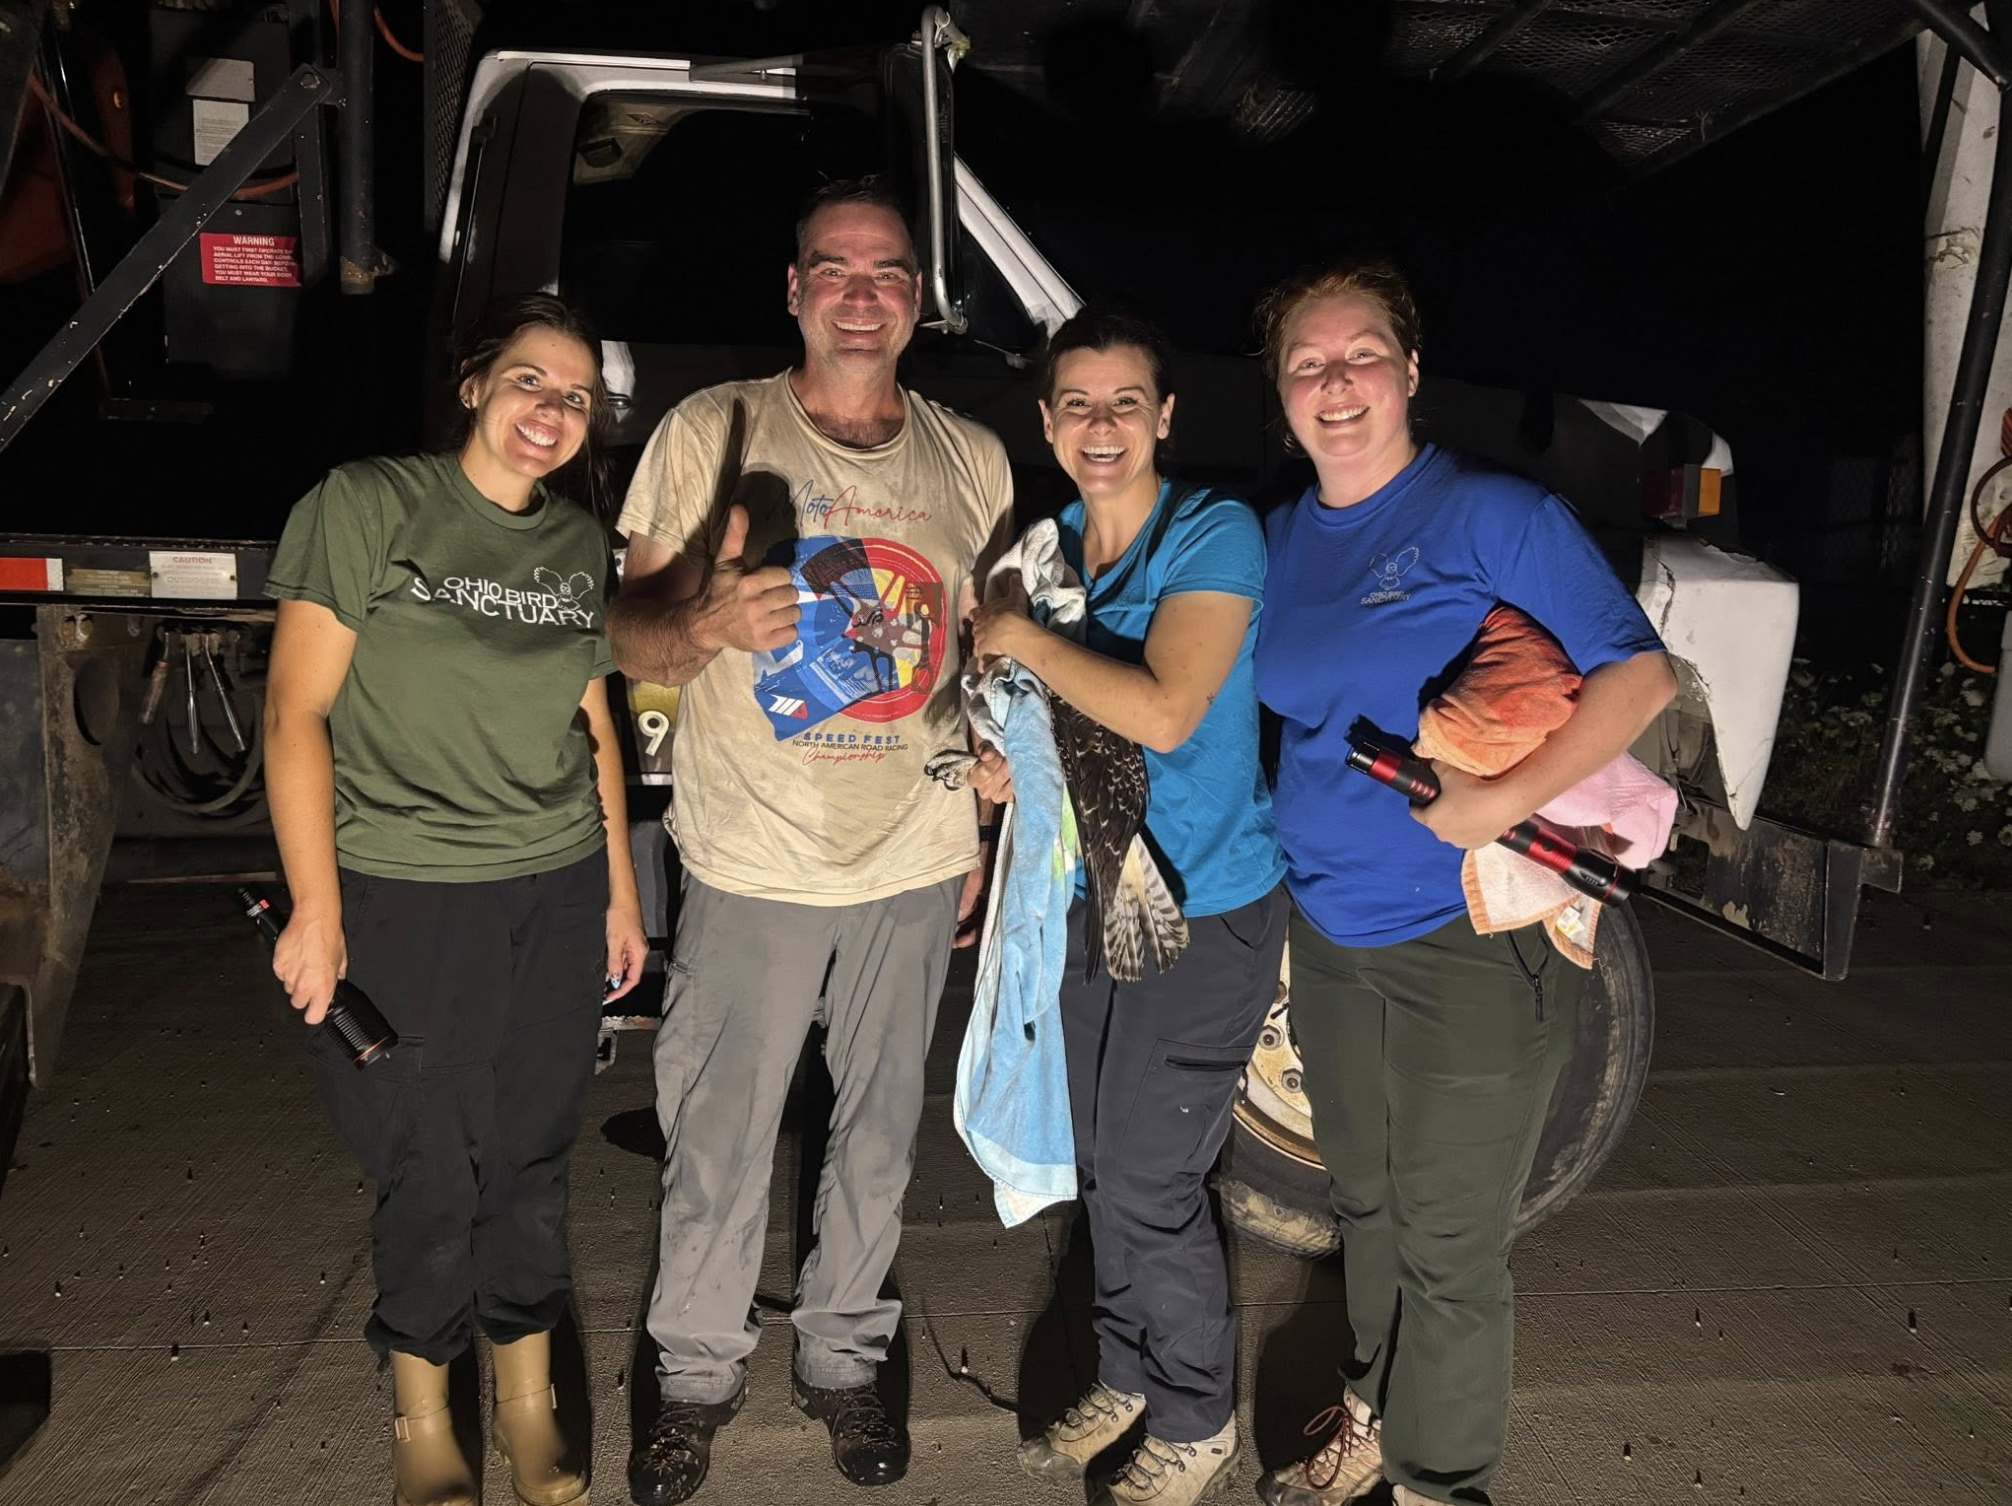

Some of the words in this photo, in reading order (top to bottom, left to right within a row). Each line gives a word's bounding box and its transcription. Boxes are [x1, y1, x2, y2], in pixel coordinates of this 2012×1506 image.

[233, 236, 275, 246] WARNING
[410, 577, 595, 629] SANCTUARY
[443, 576, 502, 599] OHIO
[505, 588, 559, 610] BIRD
[638, 710, 670, 757] 9
[803, 732, 856, 743] SPEED
[864, 734, 900, 745] FEST
[792, 740, 819, 748] NORTH
[821, 742, 859, 750] AMERICAN
[861, 743, 883, 751] ROAD
[885, 743, 908, 751] RACING
[802, 745, 887, 766] Championship
